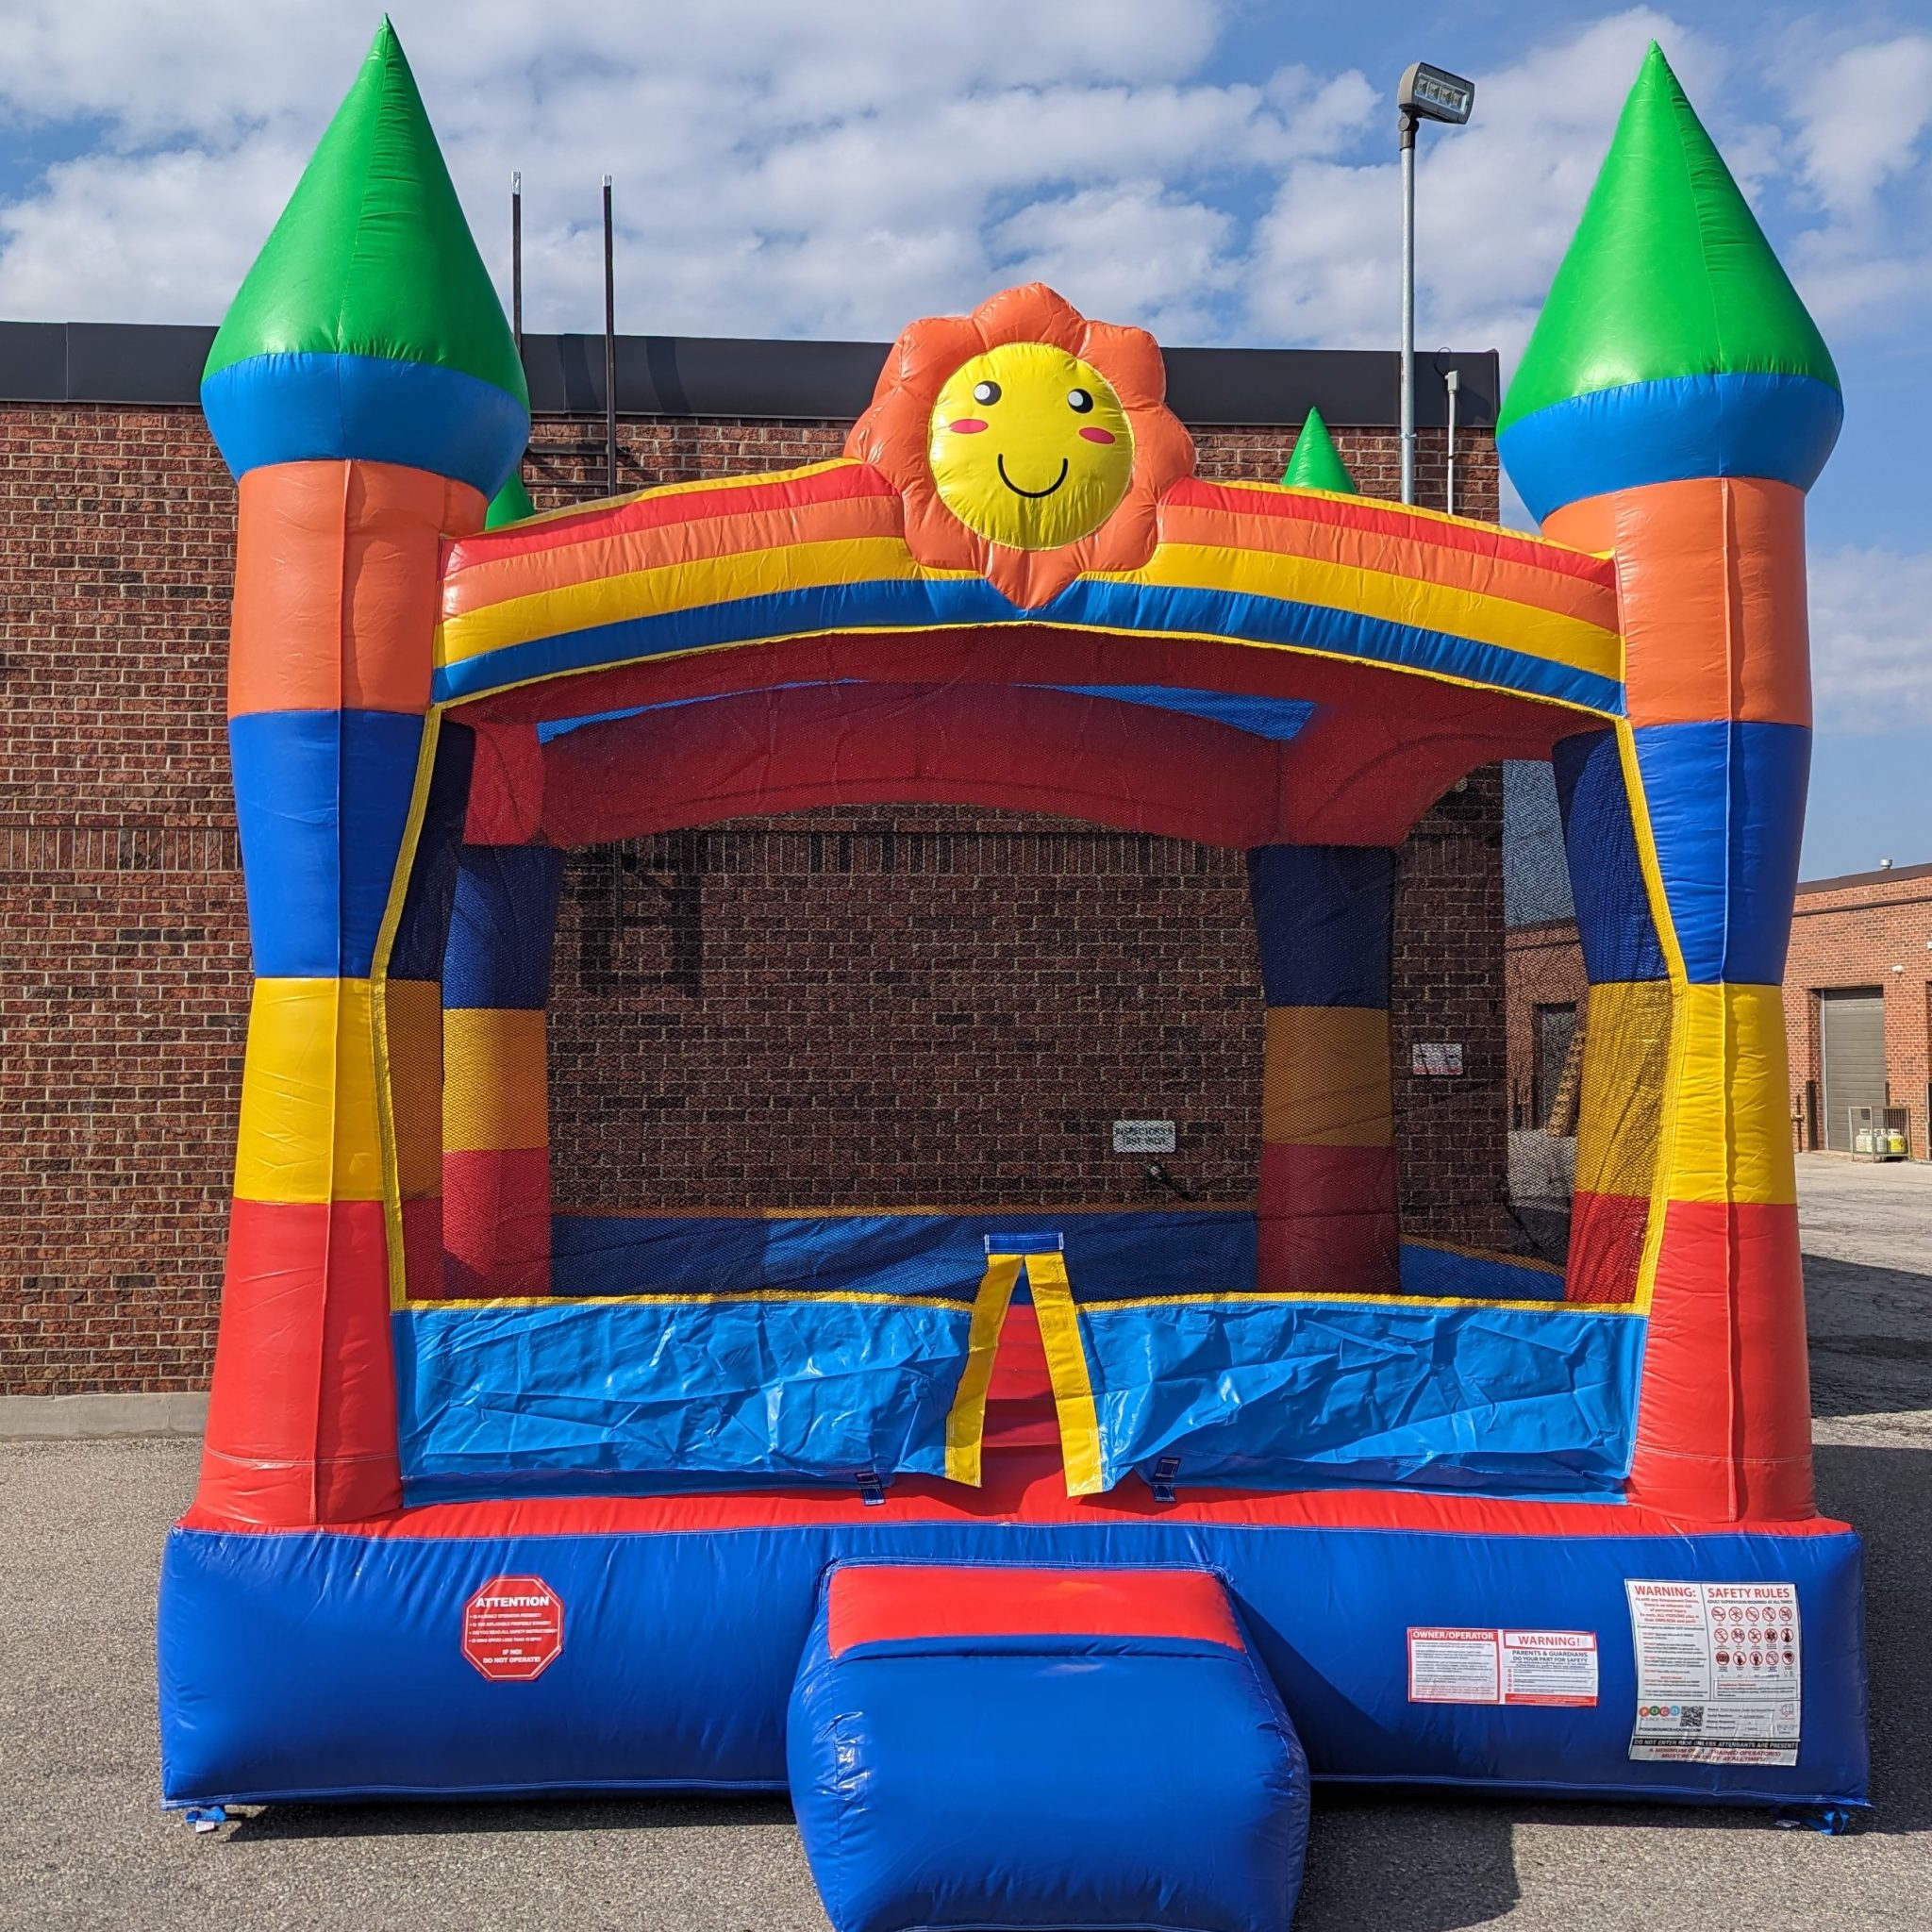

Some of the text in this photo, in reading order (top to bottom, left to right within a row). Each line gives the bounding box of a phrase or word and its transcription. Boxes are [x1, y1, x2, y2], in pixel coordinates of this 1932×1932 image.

[1634, 1585, 1696, 1597] WARNING:
[1707, 1588, 1790, 1598] SAFETY RULES
[475, 1596, 549, 1607] ATTENTION
[1413, 1631, 1494, 1640] OWNER/OPERATOR
[1518, 1636, 1580, 1646] WARNING!
